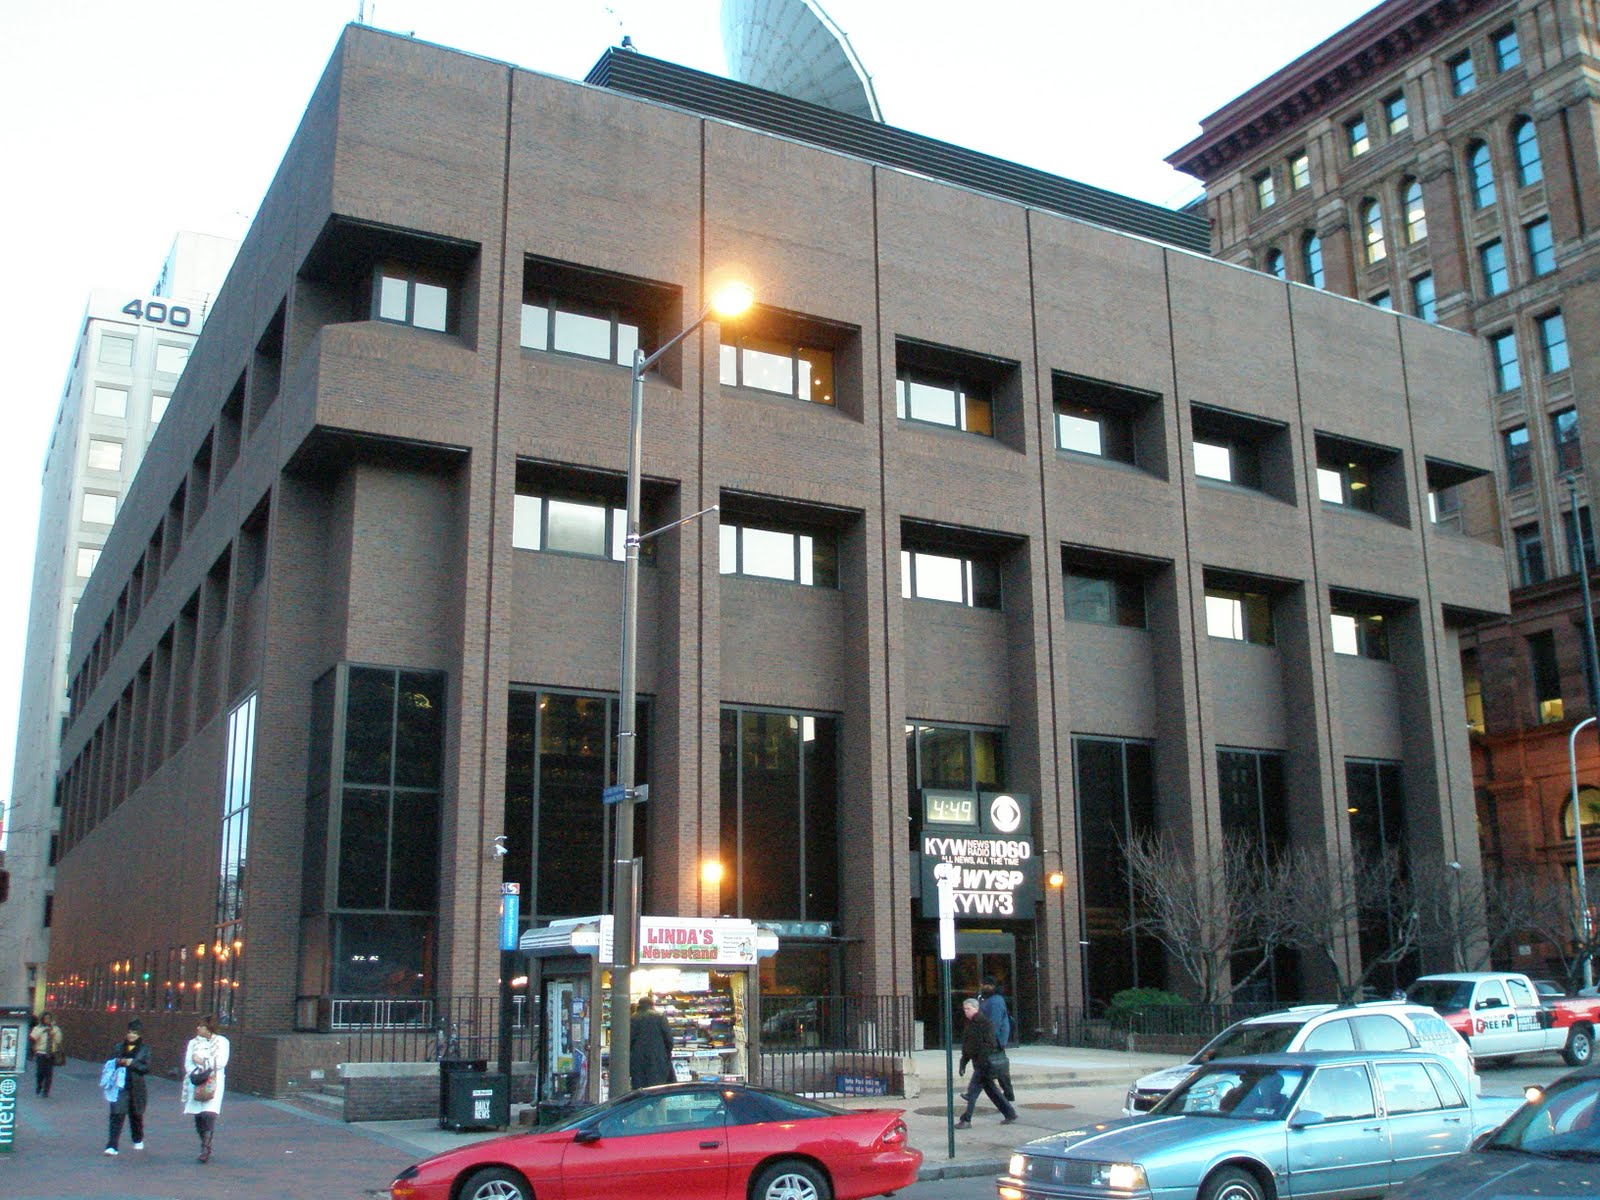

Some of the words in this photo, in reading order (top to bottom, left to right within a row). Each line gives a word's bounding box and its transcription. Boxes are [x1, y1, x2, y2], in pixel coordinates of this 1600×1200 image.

[122, 299, 191, 328] 400
[933, 799, 972, 821] 4:49
[924, 837, 967, 856] KYW
[967, 840, 990, 849] NEWS
[967, 848, 990, 857] RADIO
[989, 840, 1031, 860] 1060
[941, 855, 953, 864] ALL
[976, 856, 989, 865] ALL
[989, 857, 1003, 866] THE
[1003, 858, 1020, 866] TIME
[962, 869, 1024, 891] WYSP
[647, 928, 714, 945] LINDA'S
[642, 945, 718, 960] Newsstand
[1476, 1019, 1500, 1031] FREE
[1501, 1017, 1513, 1028] FM
[474, 1110, 491, 1119] NEWS
